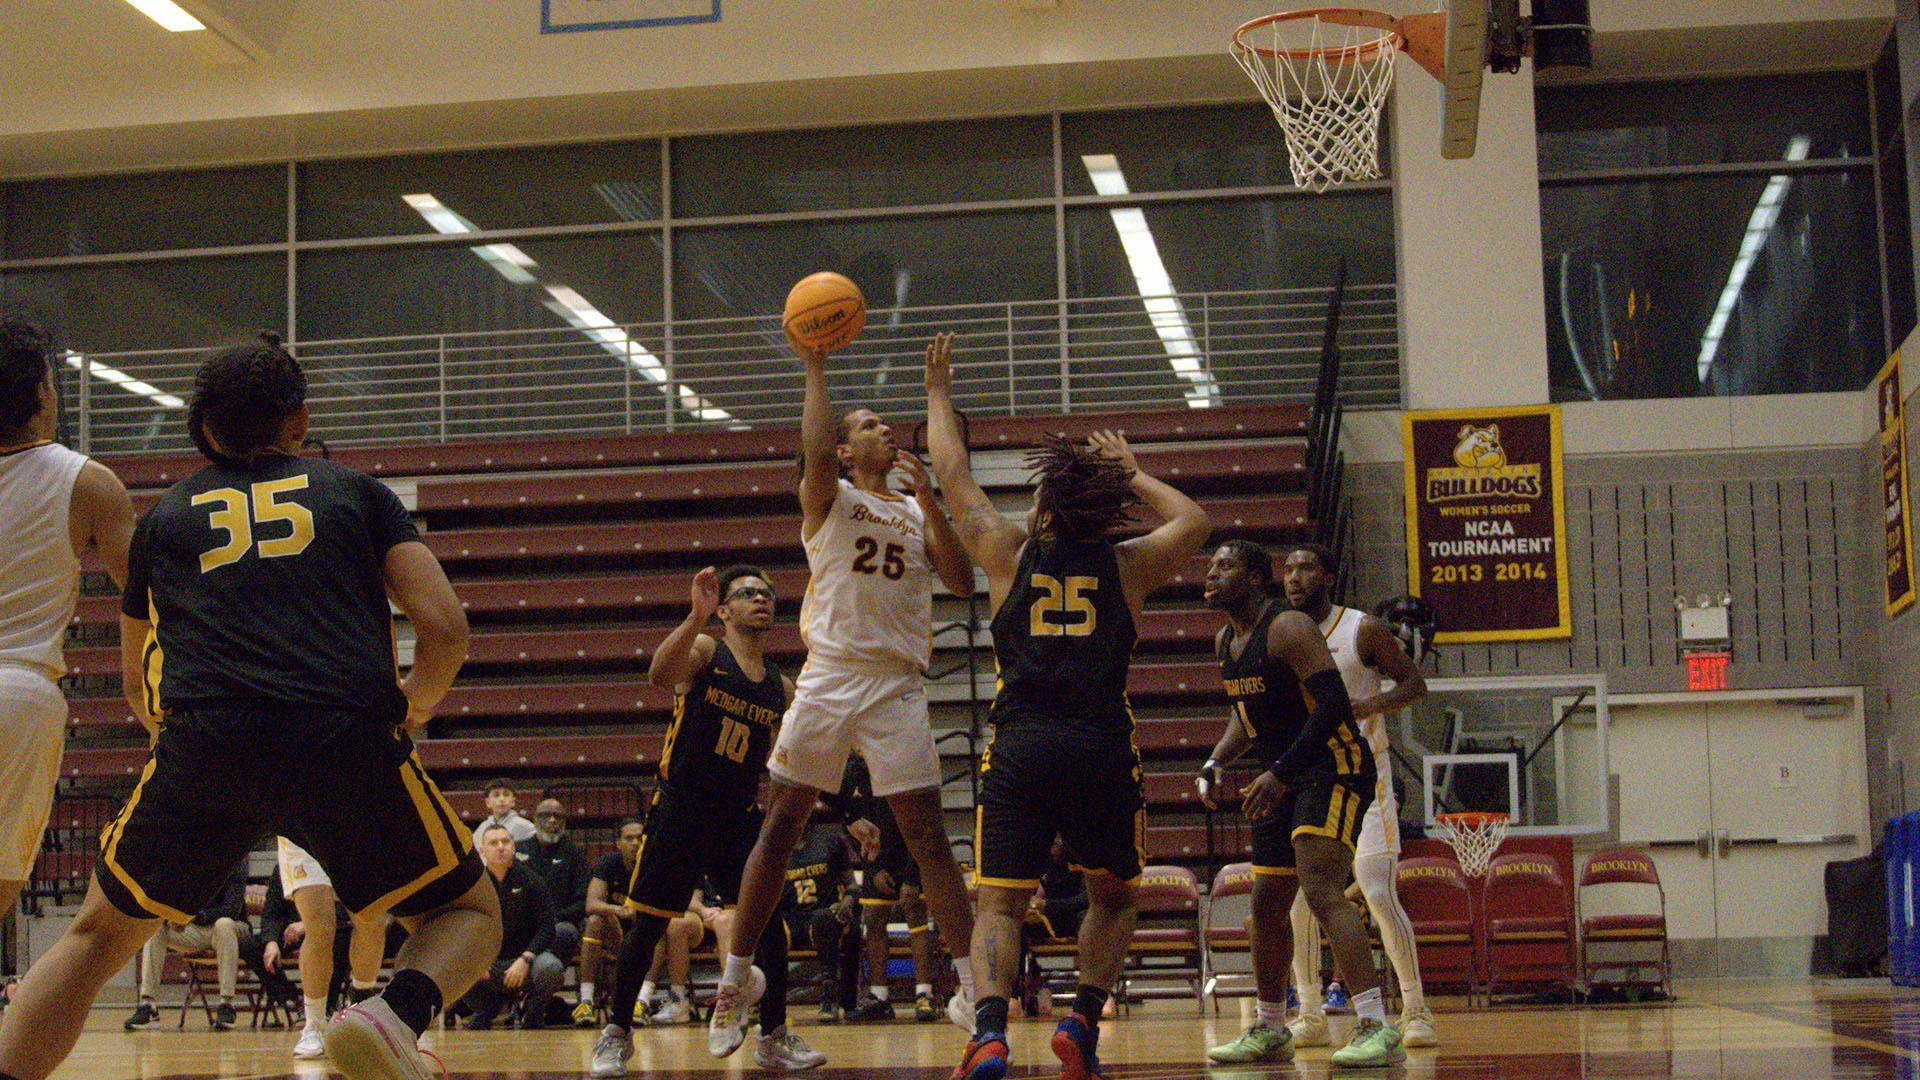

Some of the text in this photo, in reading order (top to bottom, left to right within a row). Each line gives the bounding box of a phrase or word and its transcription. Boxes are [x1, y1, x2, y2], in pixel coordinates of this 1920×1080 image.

[799, 309, 846, 334] Wilson
[1429, 476, 1538, 499] BULLDOGS
[849, 503, 918, 536] Brooklyn
[1440, 503, 1531, 516] WOMEN'S SOCCER
[191, 474, 315, 574] 35
[1465, 520, 1515, 537] NCAA
[852, 536, 905, 580] 25
[1428, 537, 1552, 557] TOURNAMENT
[1432, 562, 1547, 583] 2013 2014
[1030, 573, 1099, 636] 25
[1688, 657, 1727, 690] EXIT
[704, 686, 747, 717] MEDGAR
[715, 716, 751, 764] 10
[1780, 766, 1790, 778] B
[1400, 866, 1456, 879] BROOKLYN
[1496, 862, 1552, 876] BROOKLYN
[1591, 860, 1648, 873] BROOKLYN
[1140, 874, 1191, 887] ROOKLYN
[1224, 872, 1256, 884] BROO
[794, 879, 817, 904] 12
